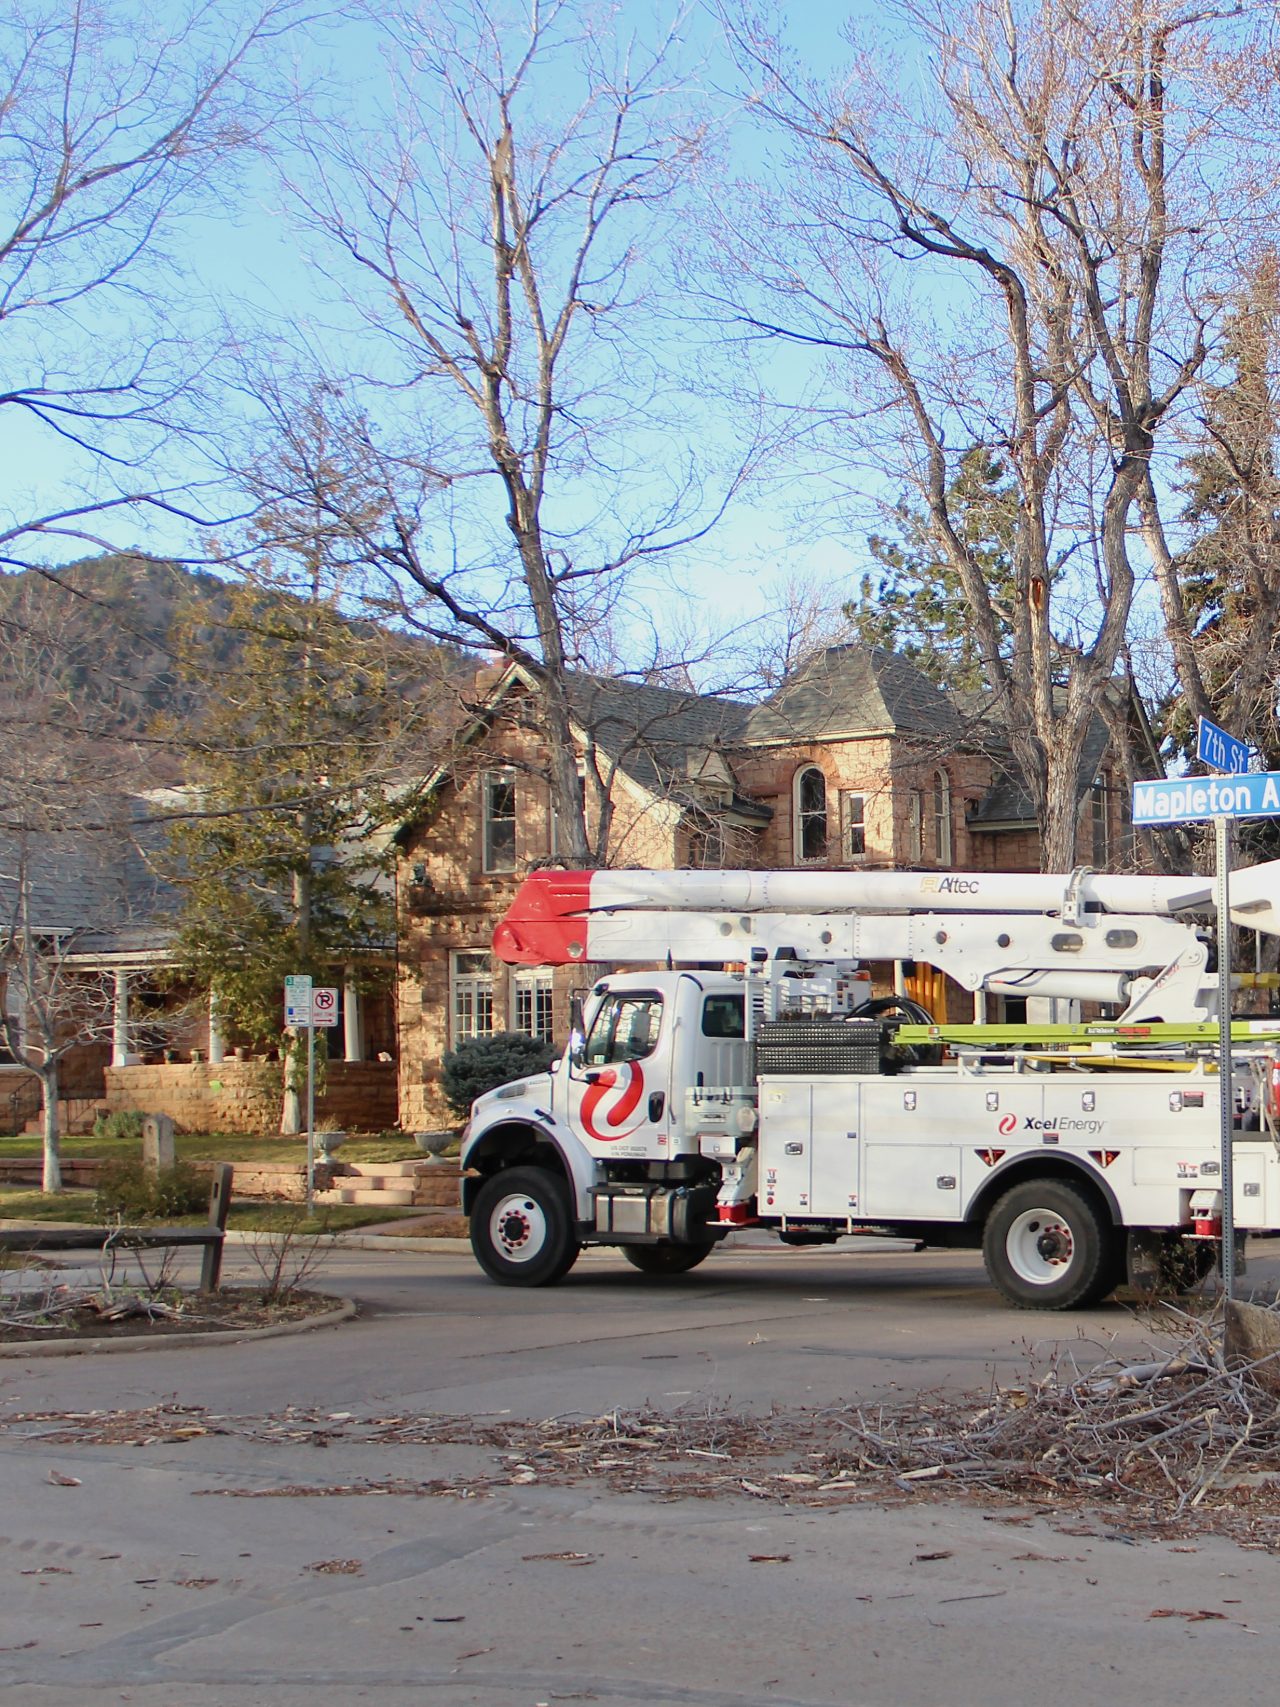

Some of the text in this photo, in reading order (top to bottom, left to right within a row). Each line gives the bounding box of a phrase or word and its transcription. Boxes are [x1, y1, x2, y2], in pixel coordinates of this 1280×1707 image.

[1205, 725, 1244, 773] 7th St
[1135, 782, 1252, 819] Mapleton
[938, 877, 980, 894] Altec
[1024, 1117, 1105, 1134] Xcel Energy
